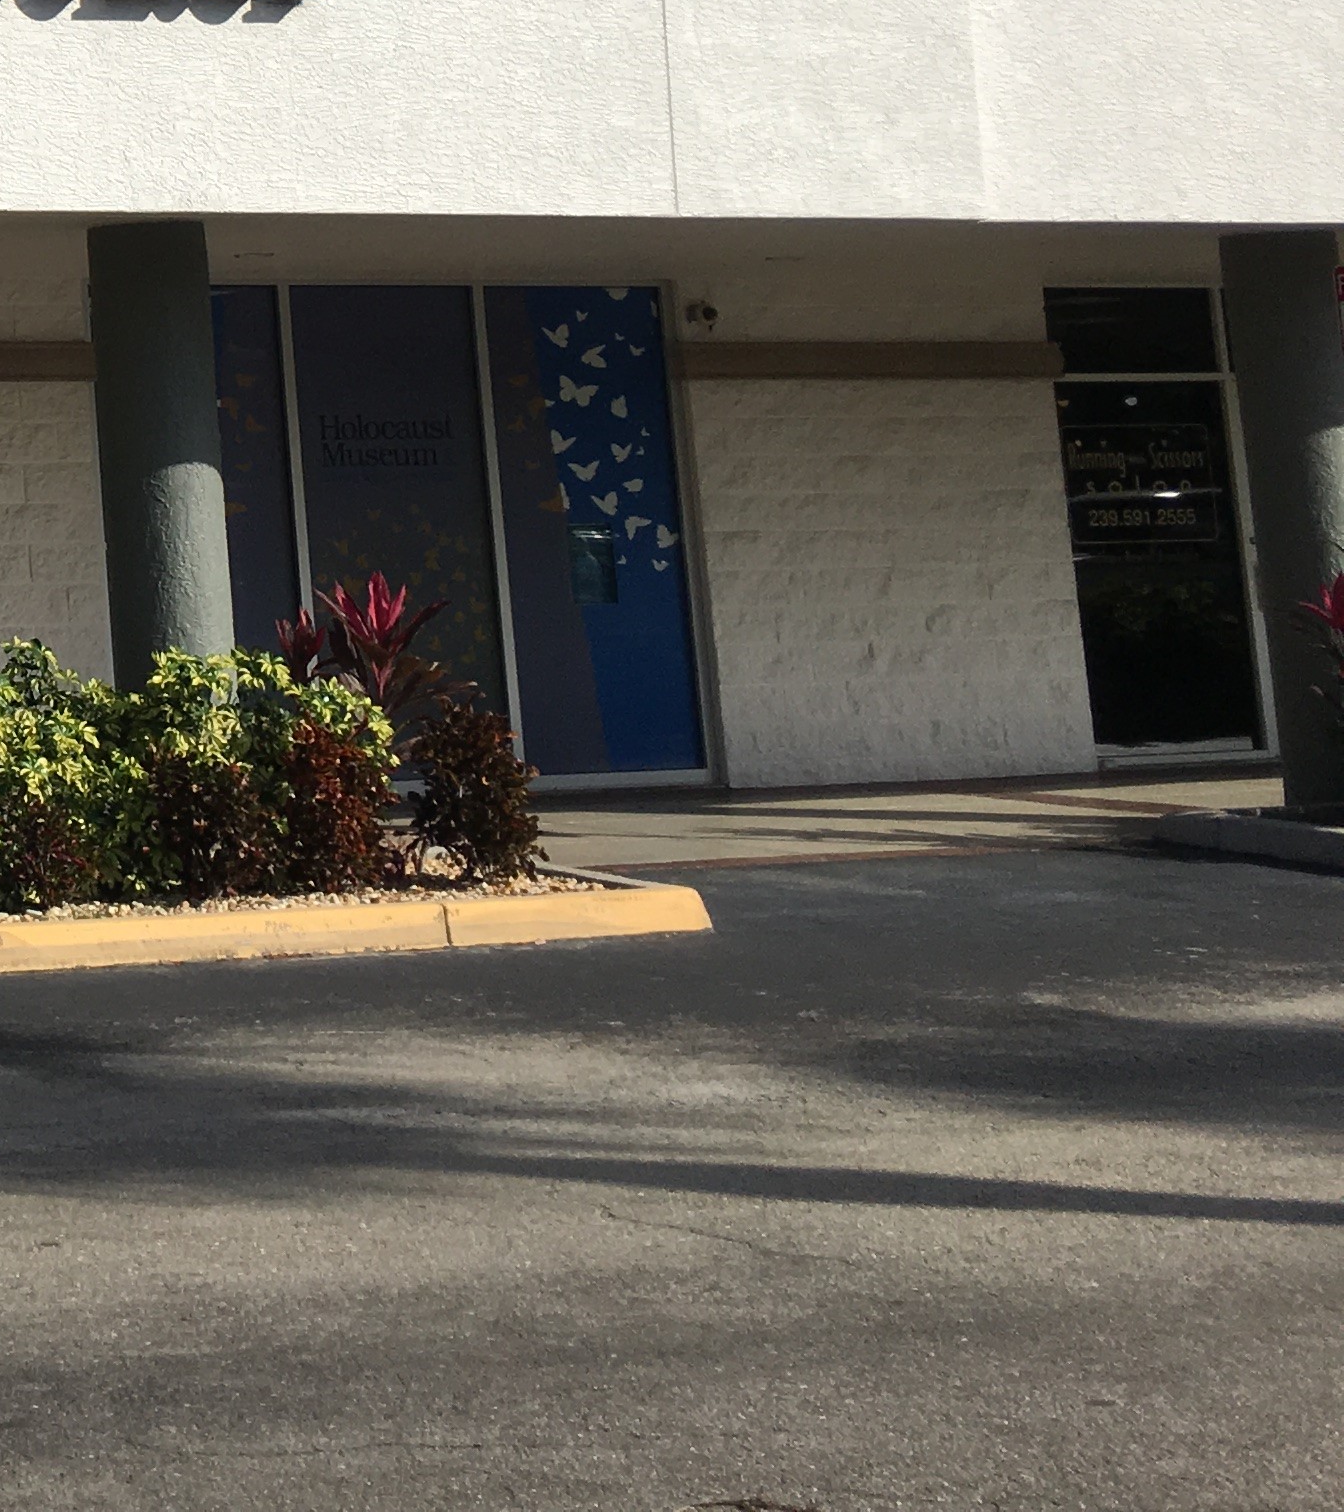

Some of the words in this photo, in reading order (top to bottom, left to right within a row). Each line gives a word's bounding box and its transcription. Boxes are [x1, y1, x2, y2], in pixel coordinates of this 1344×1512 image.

[319, 414, 456, 440] Holocaust
[321, 442, 440, 467] Museum
[1087, 508, 1197, 527] 239.591.2555
